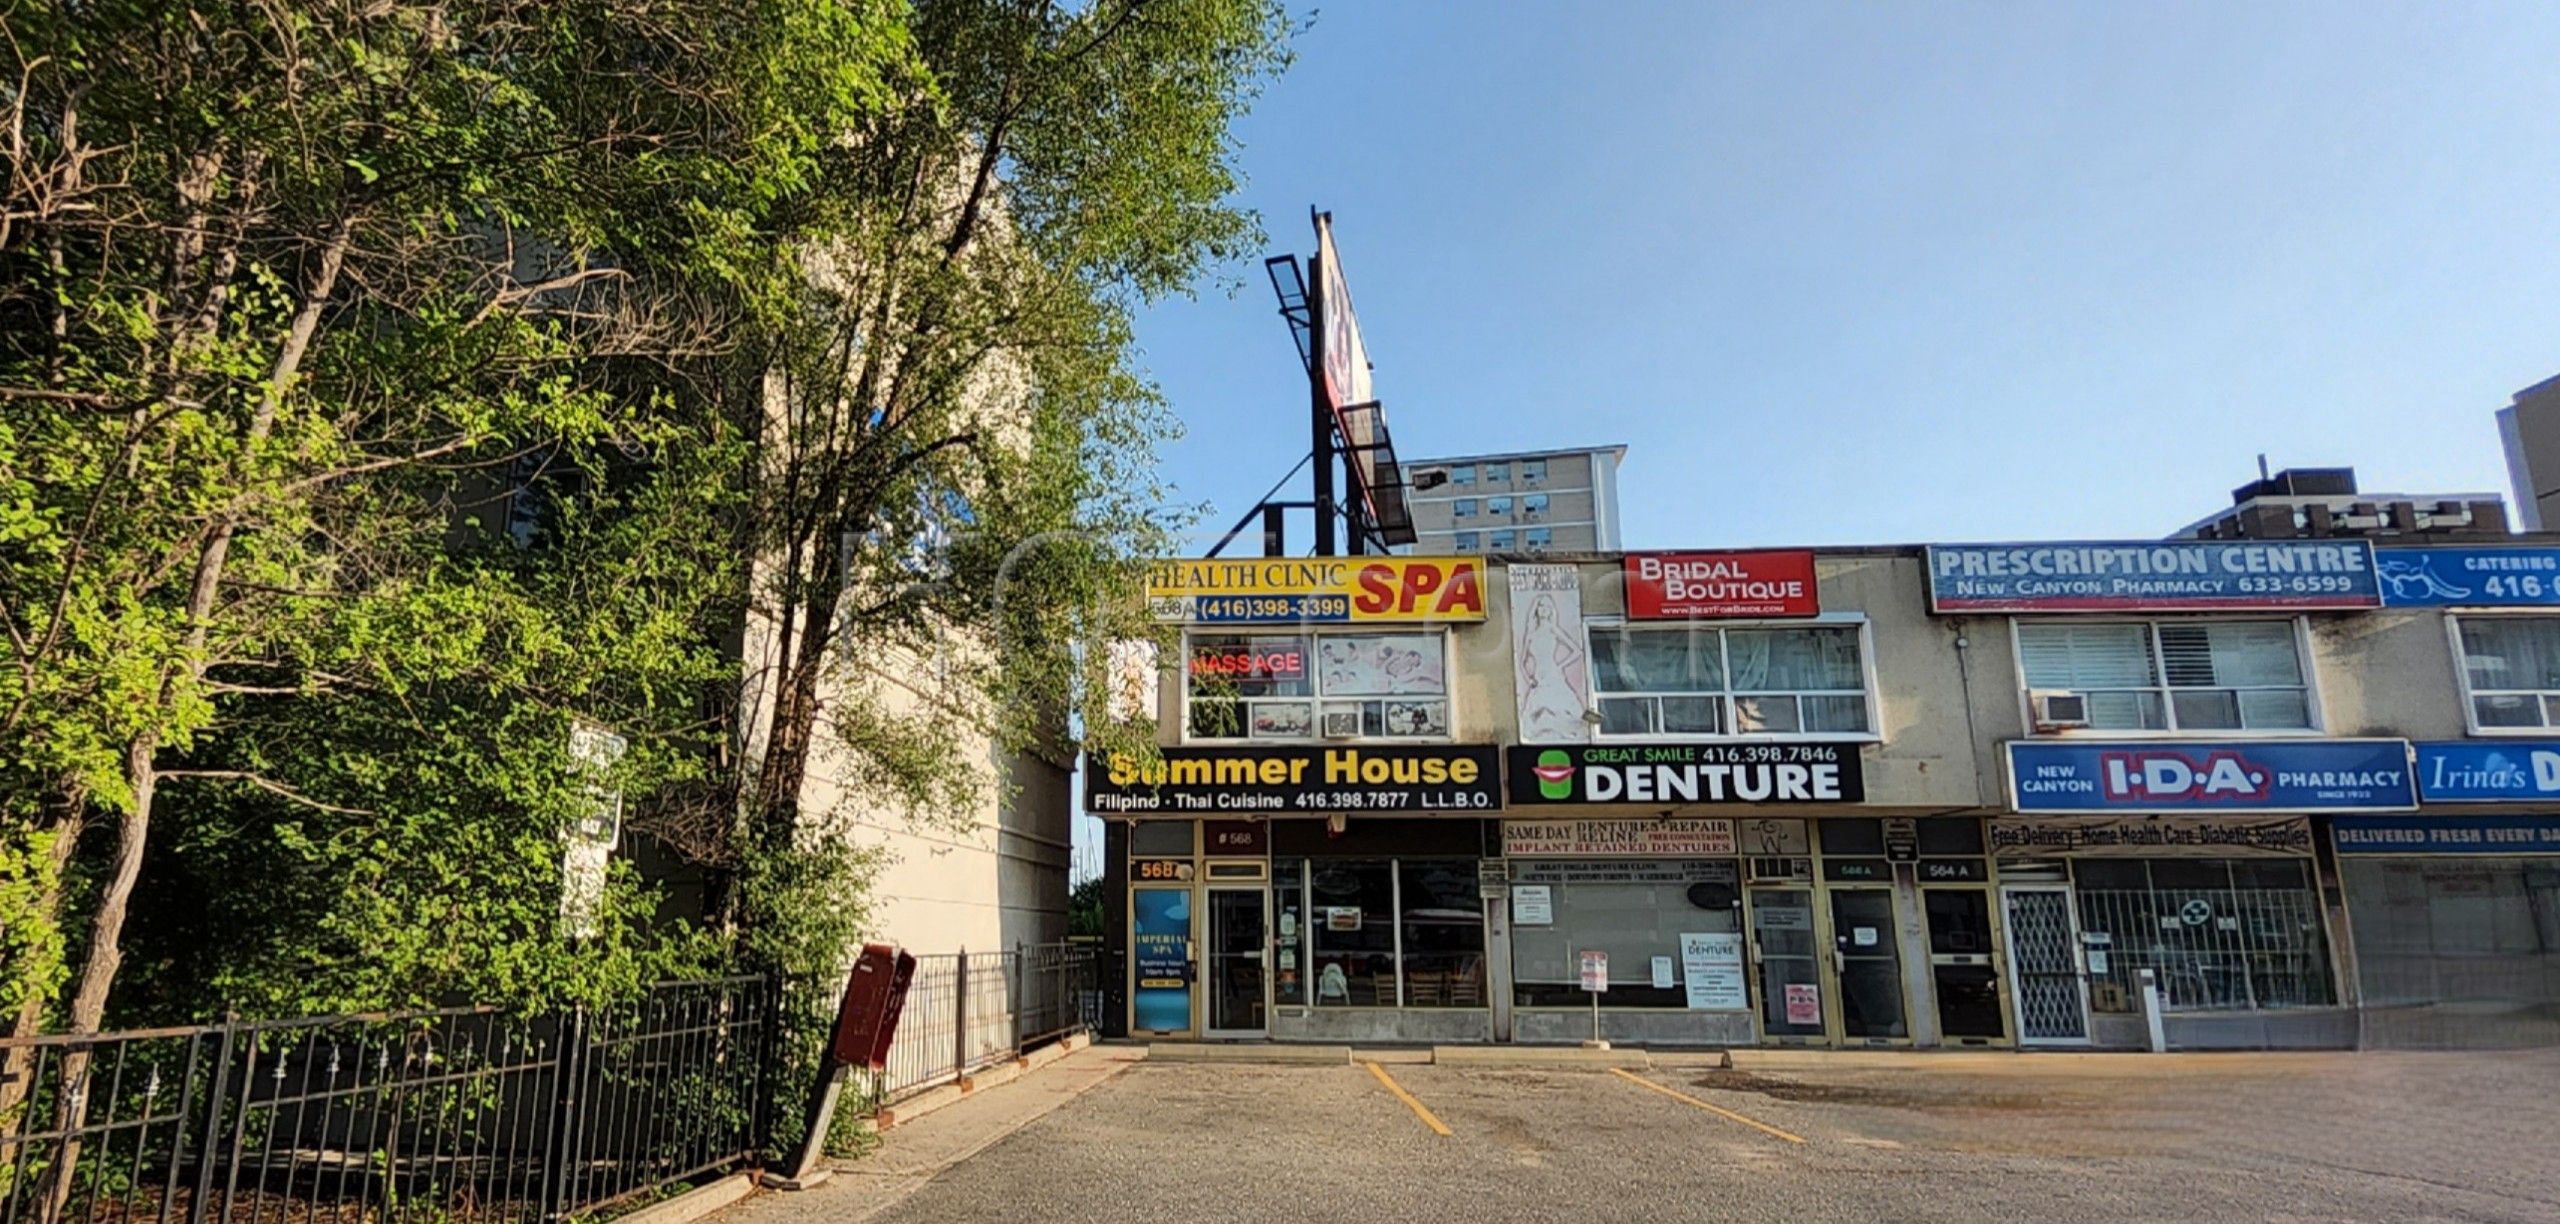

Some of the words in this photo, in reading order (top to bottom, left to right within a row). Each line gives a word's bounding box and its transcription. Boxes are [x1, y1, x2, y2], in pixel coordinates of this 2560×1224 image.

[1639, 557, 1749, 580] BRIDAL
[1938, 548, 2209, 577] PRESCRIPTION
[2220, 546, 2366, 573] CENTRE
[2464, 557, 2557, 571] CATERING
[1151, 562, 1258, 589] HEALTH
[1265, 562, 1348, 588] CLNIC
[1957, 581, 2005, 596] NEW
[2015, 579, 2103, 595] CANYON
[2113, 578, 2225, 594] PHARMACY
[2239, 576, 2352, 593] 633-6599
[1355, 562, 1482, 614] SPA
[1665, 580, 1804, 601] BOUTIQUE
[1200, 597, 1346, 620] (416)398-3399
[1190, 652, 1301, 674] MASSAGE
[1583, 749, 1640, 763] GREAT
[1644, 748, 1695, 762] SMILE
[1702, 747, 1838, 763] 416.398.7846
[1107, 750, 1310, 786] Summer
[1324, 749, 1479, 785] House
[2037, 765, 2076, 779] NEW
[2278, 771, 2402, 787] PHARMACY
[2430, 755, 2526, 790] Irina's
[1585, 764, 1842, 802] DENTURE
[2023, 779, 2094, 793] CANYON
[1095, 793, 1160, 812] Filipino
[1175, 793, 1212, 809] Thai
[1217, 793, 1285, 809] Cuisine
[1295, 791, 1410, 808] 416.398.7877
[1420, 792, 1495, 809] L.L.B.O.
[1507, 826, 1543, 840] SAME
[1545, 826, 1572, 840] DAY
[1576, 822, 1659, 833] DENTURES
[1669, 821, 1729, 832] REPAIR
[1576, 832, 1640, 842] RELINE
[1990, 825, 2018, 845] Free
[2255, 825, 2311, 850] Supplies
[2338, 829, 2425, 843] DELIVERED
[2430, 829, 2481, 843] FRESH
[2486, 828, 2535, 843] EVERY
[1230, 832, 1252, 845] 568
[1507, 843, 1570, 853] IMPLANT
[1575, 843, 1648, 853] RETAINED
[1652, 843, 1731, 852] DENTURES
[1929, 865, 1954, 876] 564
[1958, 866, 1968, 876] A
[1688, 946, 1735, 955] DENTURE
